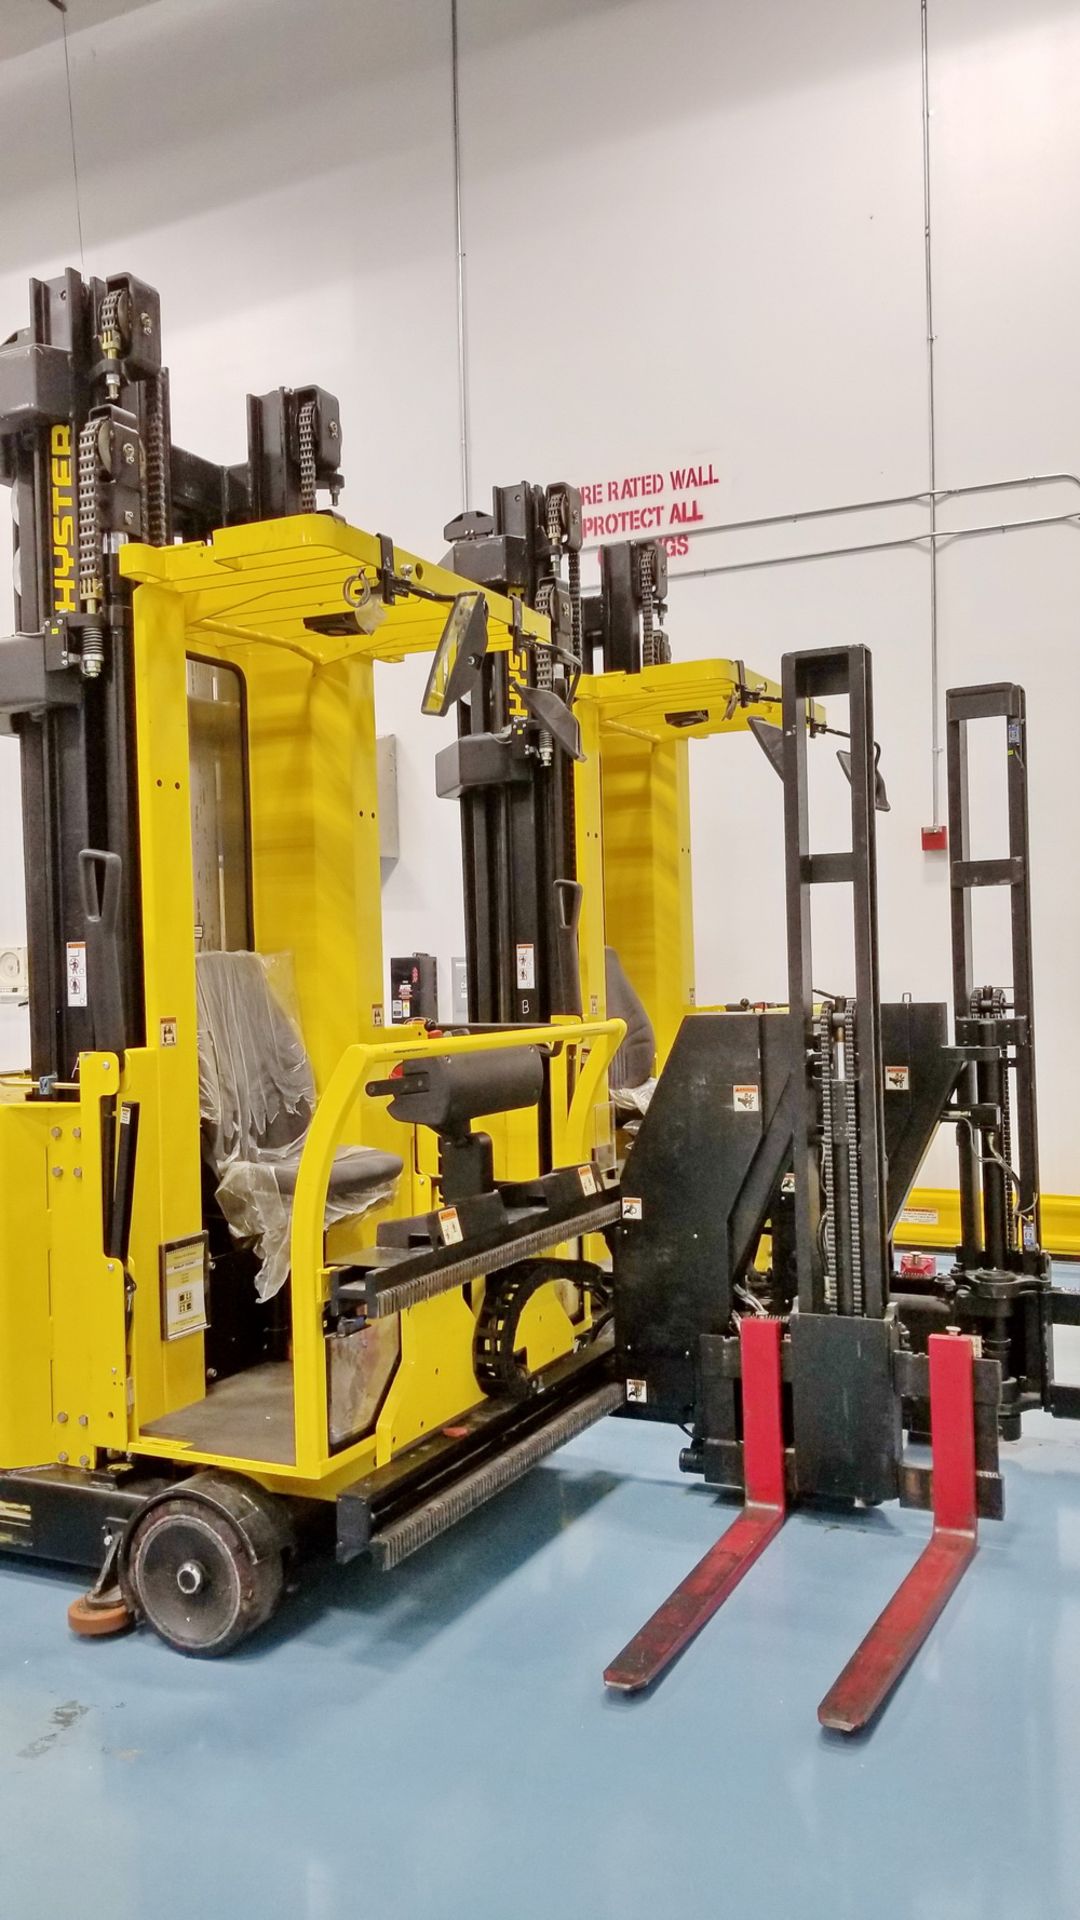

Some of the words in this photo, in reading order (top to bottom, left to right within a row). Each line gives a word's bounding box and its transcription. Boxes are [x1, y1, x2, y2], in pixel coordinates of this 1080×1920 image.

[579, 484, 603, 506] RE
[608, 474, 664, 502] RATED
[670, 464, 719, 490] WALL
[51, 425, 77, 612] HYSTER
[582, 505, 664, 538] PROTECT
[669, 500, 704, 524] ALL
[522, 999, 530, 1014] B
